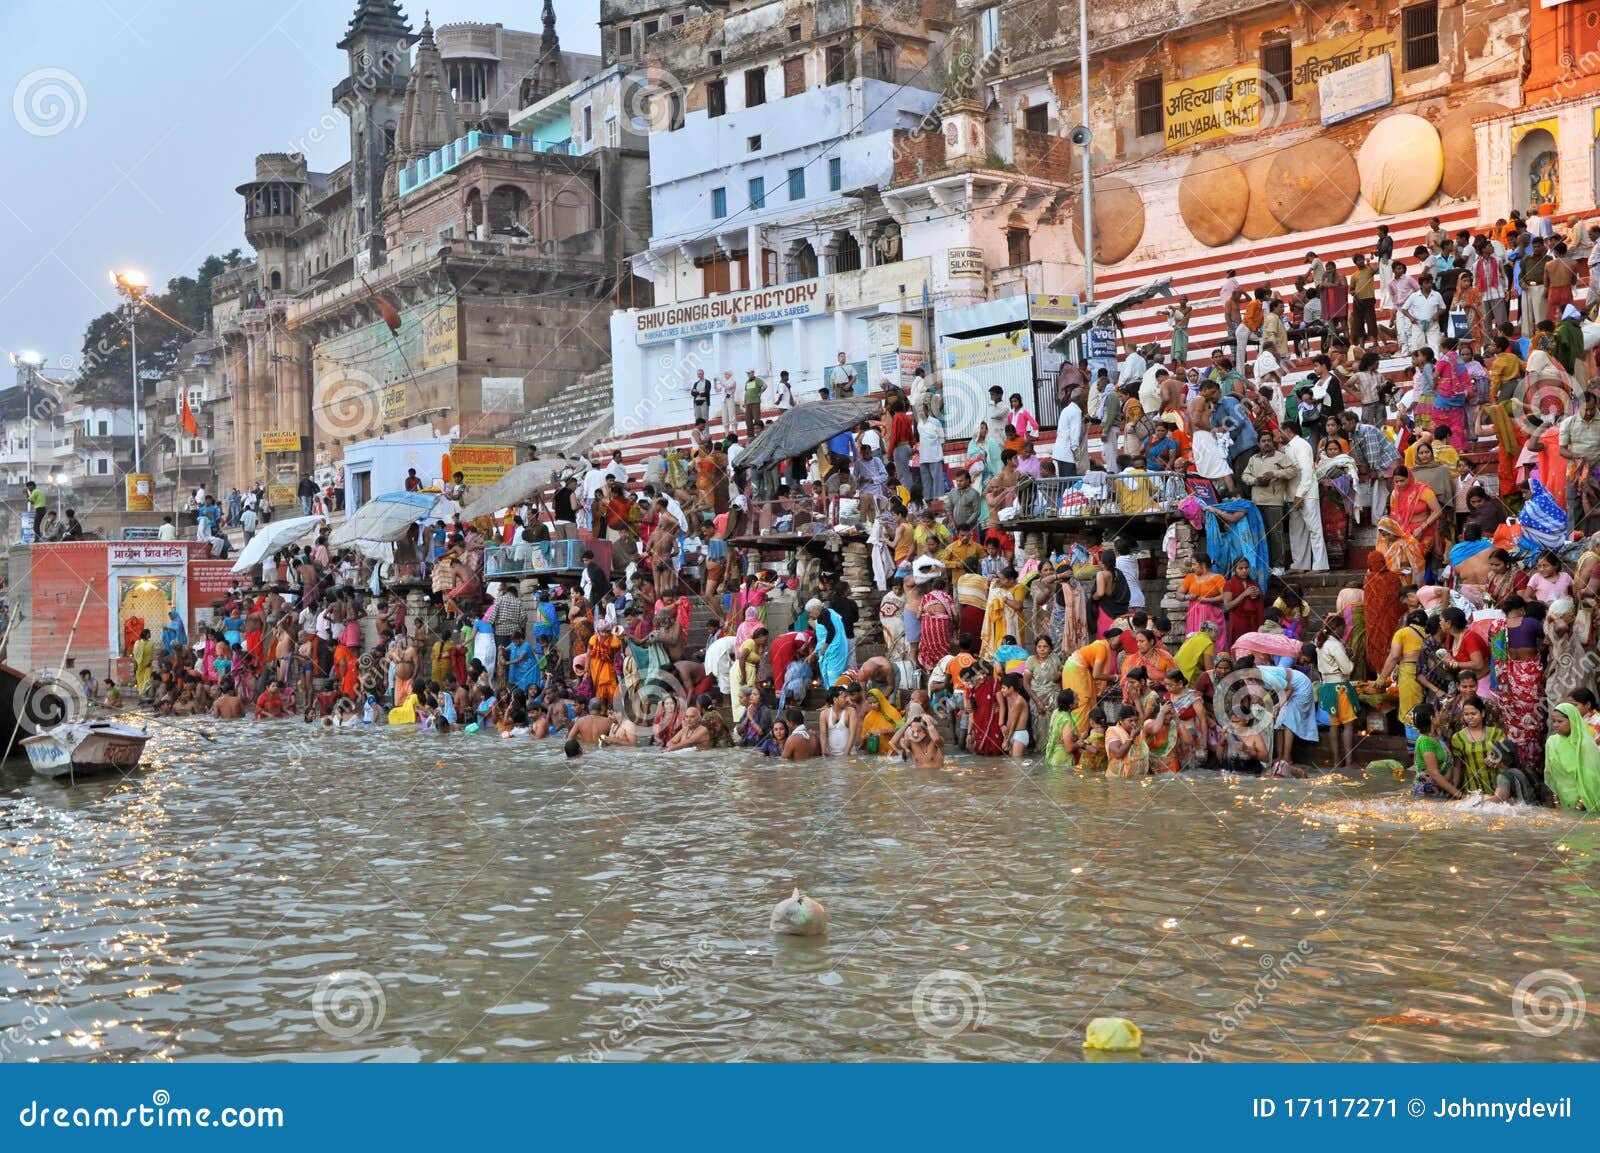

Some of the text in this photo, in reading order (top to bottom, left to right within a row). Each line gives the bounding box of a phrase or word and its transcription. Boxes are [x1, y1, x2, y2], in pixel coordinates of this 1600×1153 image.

[1166, 76, 1257, 116] अहिल्याबाई घाट
[1168, 103, 1257, 140] AHILYABAI GHAT
[637, 312, 665, 331] SHIV
[667, 303, 709, 325] GANGA
[711, 297, 743, 318] SILK
[743, 283, 818, 311] FACTORY
[708, 320, 715, 330] OF
[784, 304, 810, 316] SAREES
[144, 547, 161, 559] शिव
